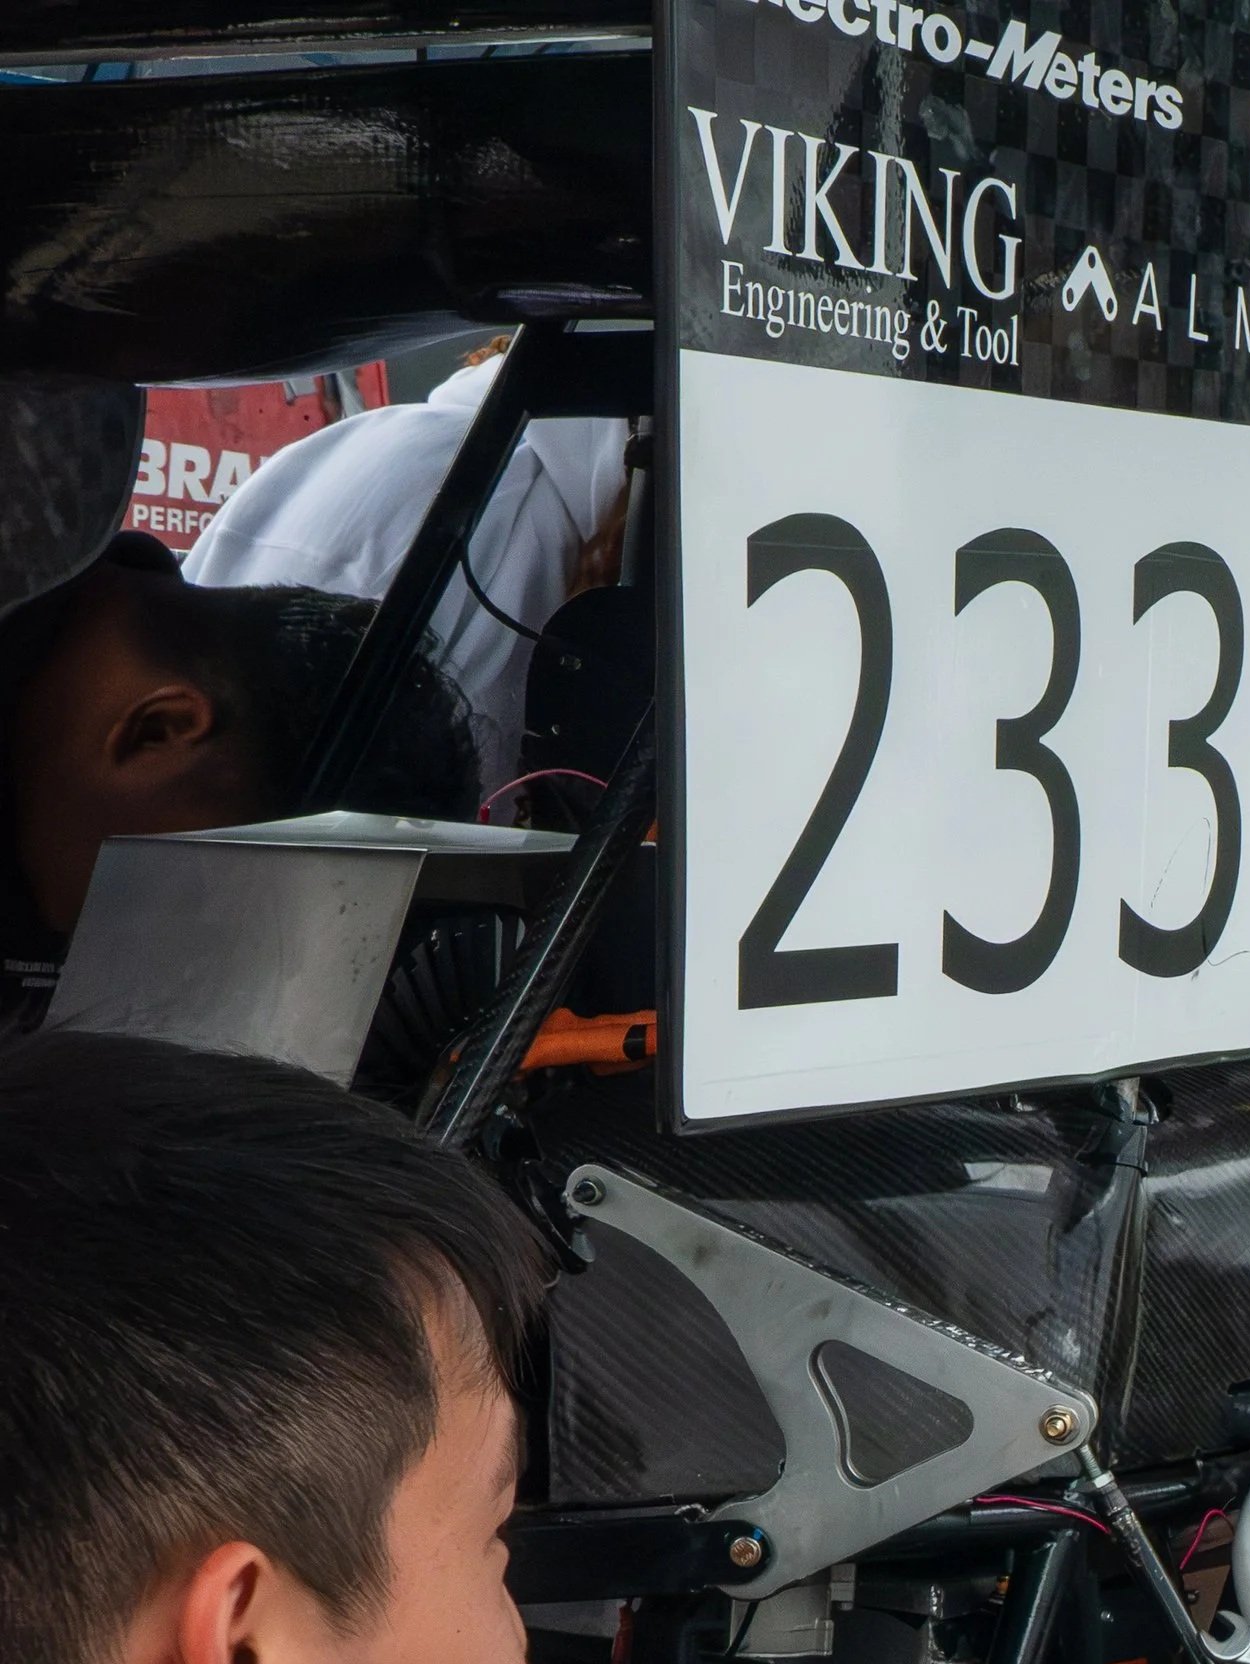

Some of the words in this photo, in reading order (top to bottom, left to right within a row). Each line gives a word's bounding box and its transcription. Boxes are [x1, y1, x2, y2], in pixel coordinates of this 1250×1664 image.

[746, 0, 1183, 130] ectro-Meters
[687, 106, 1022, 300] VIKING
[720, 259, 911, 360] Engineering
[920, 299, 948, 354] &
[957, 306, 1020, 366] Tool
[133, 438, 270, 504] BRA
[738, 511, 1245, 1010] 233
